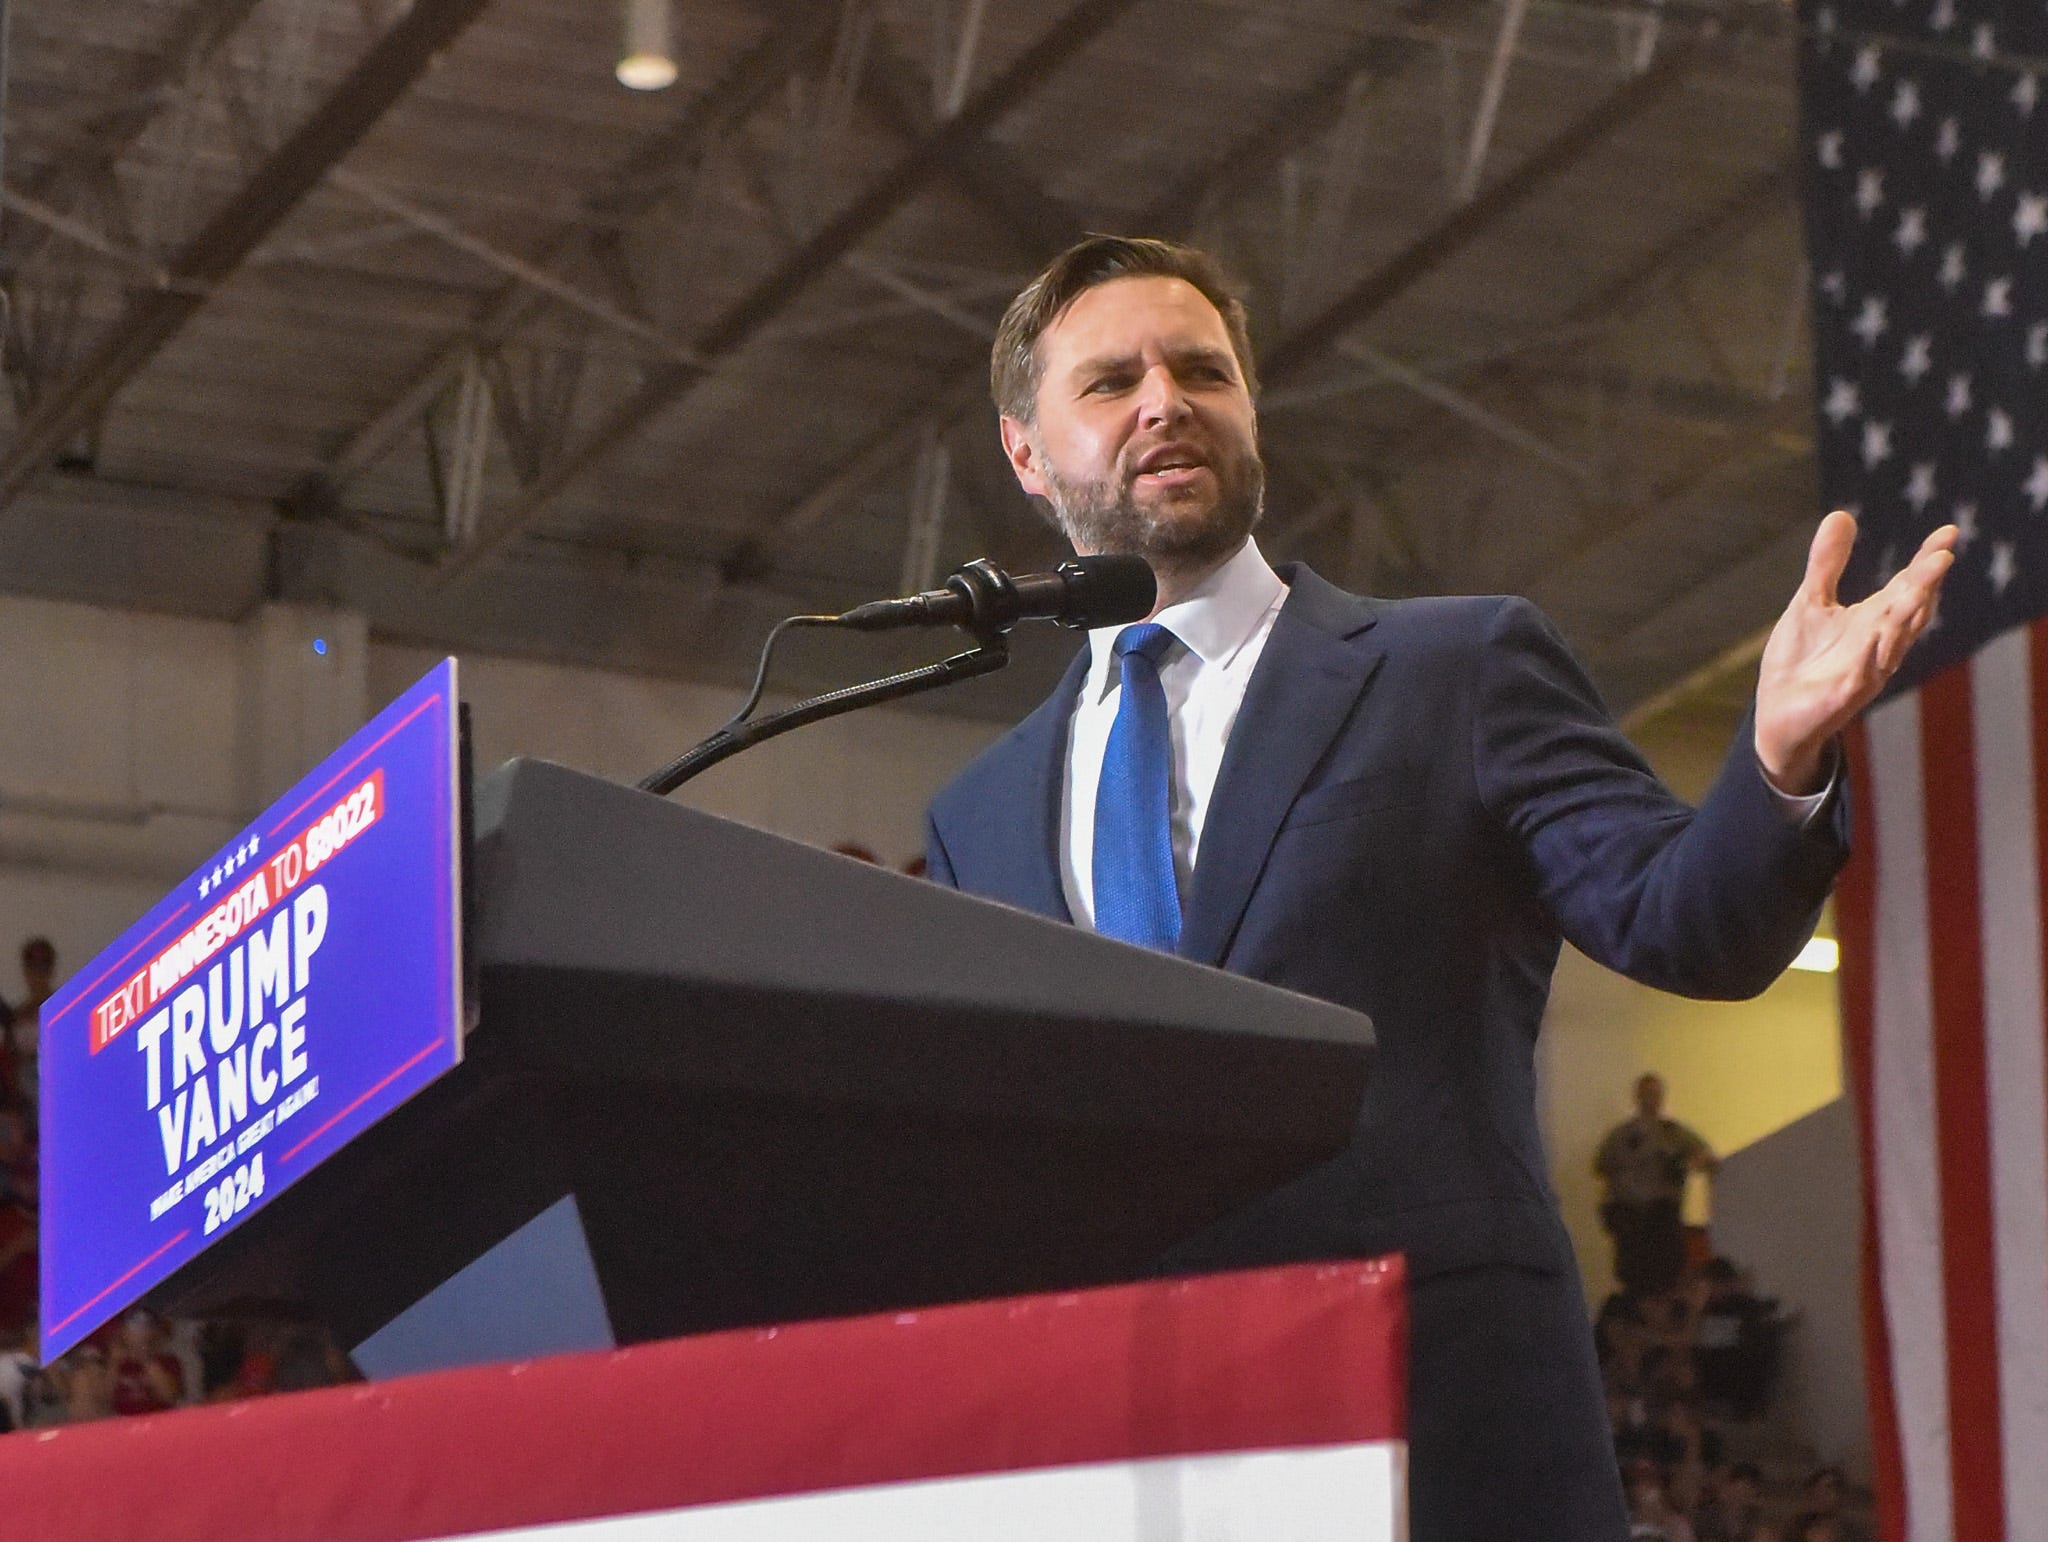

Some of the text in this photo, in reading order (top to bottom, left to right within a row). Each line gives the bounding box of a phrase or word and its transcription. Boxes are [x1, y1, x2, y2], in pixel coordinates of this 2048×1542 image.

[97, 781, 375, 1044] TEXT MINNESOTA TO 88022
[137, 884, 328, 1111] TRUMP
[158, 996, 307, 1176] VANCE
[204, 1151, 265, 1236] 2024
